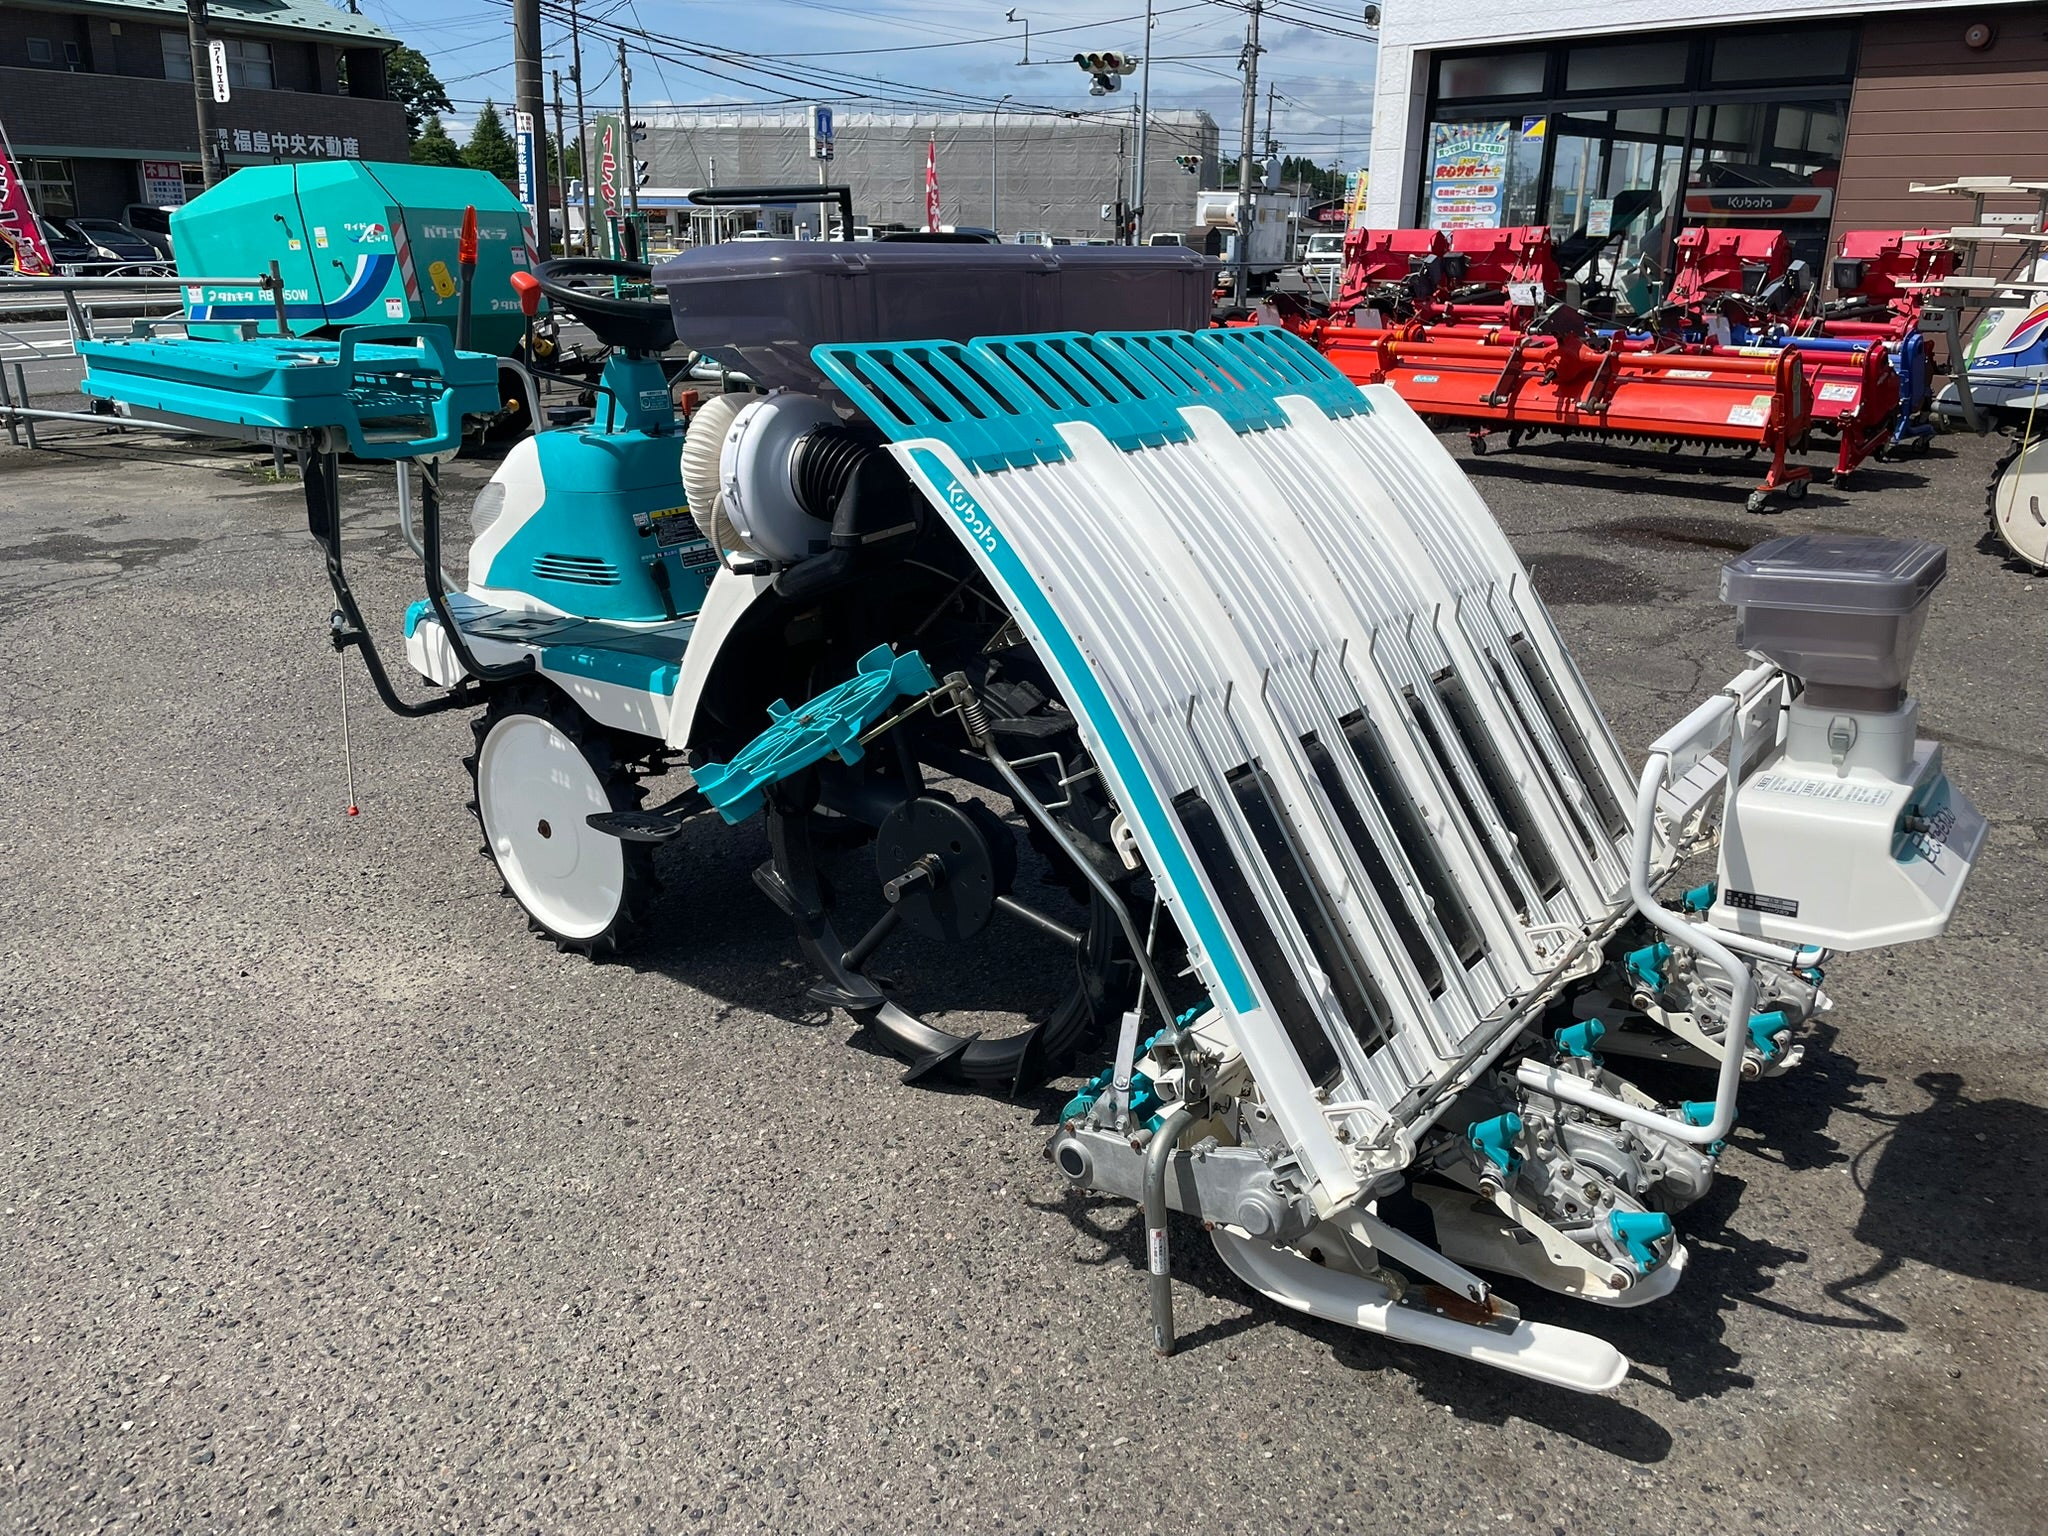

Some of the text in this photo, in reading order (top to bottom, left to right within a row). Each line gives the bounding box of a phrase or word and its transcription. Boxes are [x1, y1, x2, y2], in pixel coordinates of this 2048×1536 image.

[233, 128, 360, 158] 福島中央不動産
[1727, 196, 1773, 208] Kubota
[258, 289, 308, 301] RB50W
[946, 480, 997, 553] Kubota
